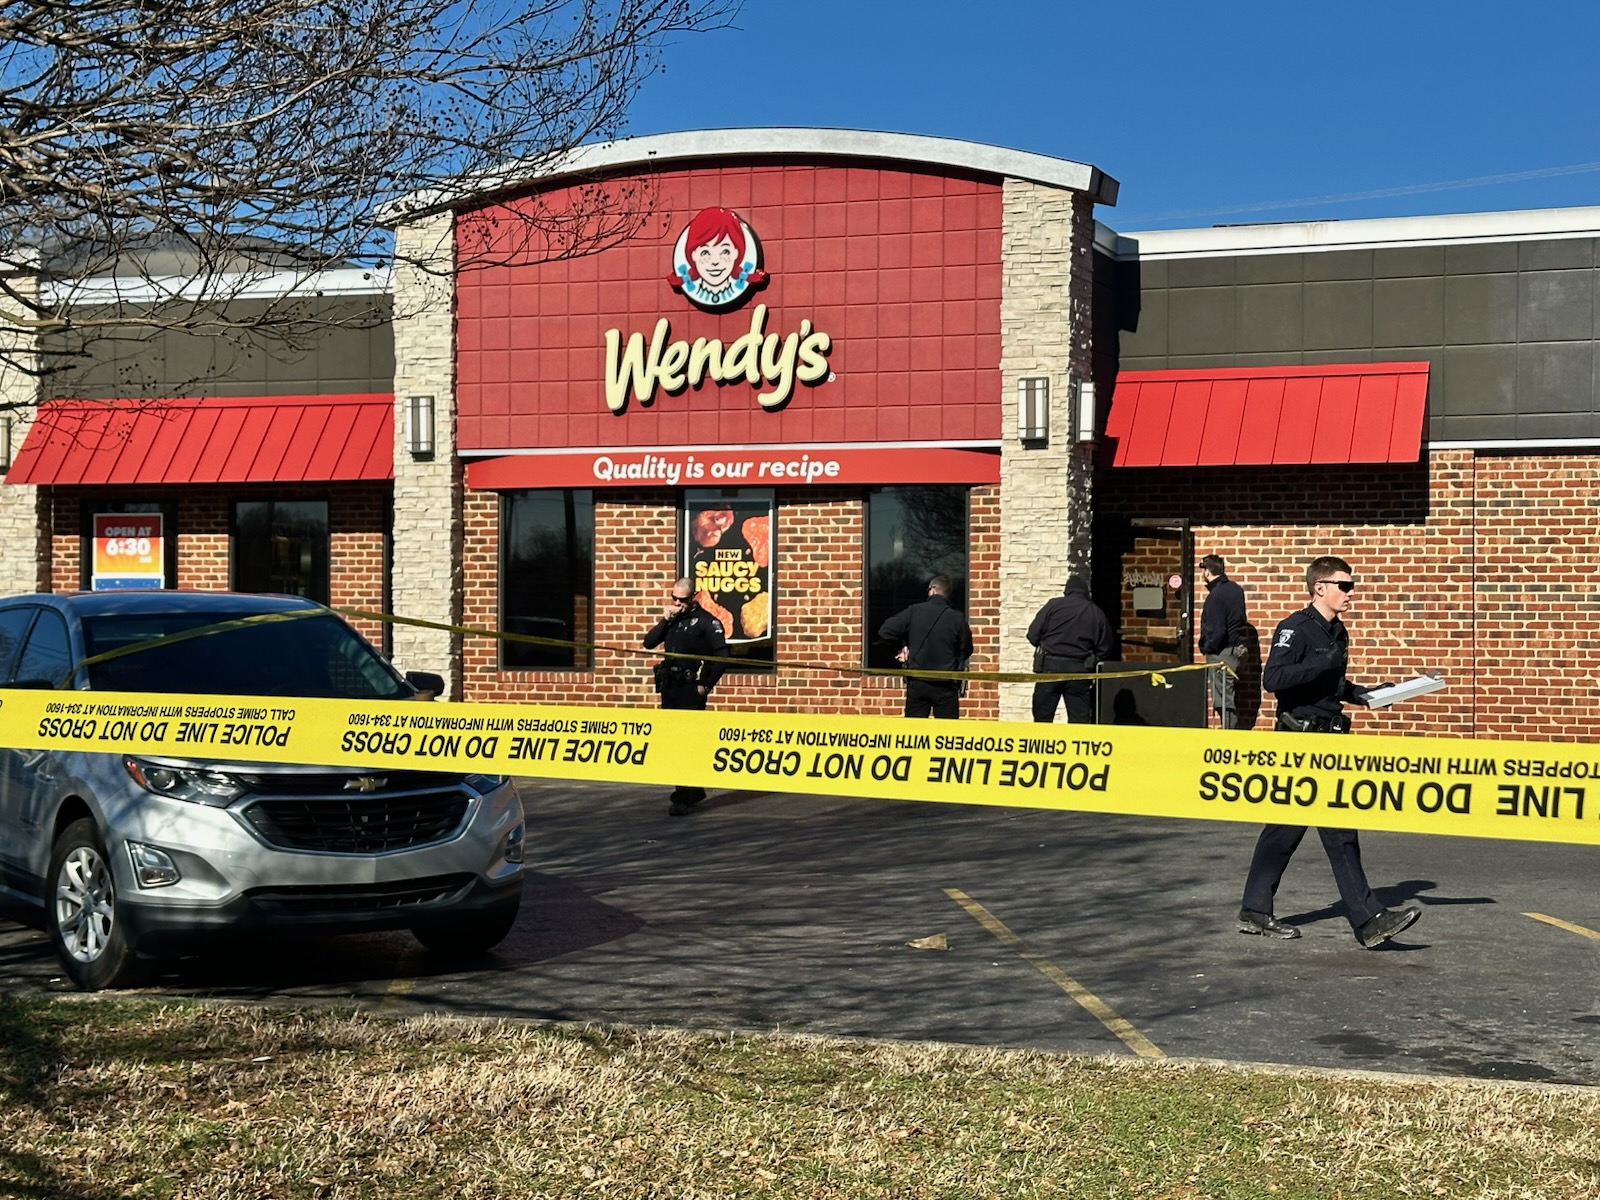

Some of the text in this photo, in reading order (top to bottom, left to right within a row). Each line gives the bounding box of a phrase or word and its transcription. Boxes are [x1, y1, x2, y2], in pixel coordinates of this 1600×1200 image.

[604, 303, 831, 412] Wendy's
[593, 455, 840, 485] Quality is our recipe
[104, 526, 152, 537] OPEN AT
[105, 538, 151, 556] 6:30
[717, 550, 740, 559] NEW
[695, 561, 760, 577] SAUCY
[695, 577, 762, 593] NUGGS
[45, 702, 296, 721] CALL CRIME STOPPERS WITH INFORMATION AT 334-1600
[348, 713, 652, 736] CALL CRIME STOPPERS WITH INFORMATION AT 334-1600
[37, 717, 292, 747] POLICE LINE DO NOT CROSS
[719, 727, 1113, 757] CALL CRIME STOPPERS WITH INFORMATION AT 334-1600
[341, 730, 649, 766] POLICE LINE DO NOT CROSS
[712, 747, 1110, 792] POLICE LINE DO NOT CROSS
[1203, 748, 1600, 780] TOPPERS WITH INFORMATION AT 334-1600
[1199, 771, 1586, 820] LINE DO NOT CROSS
